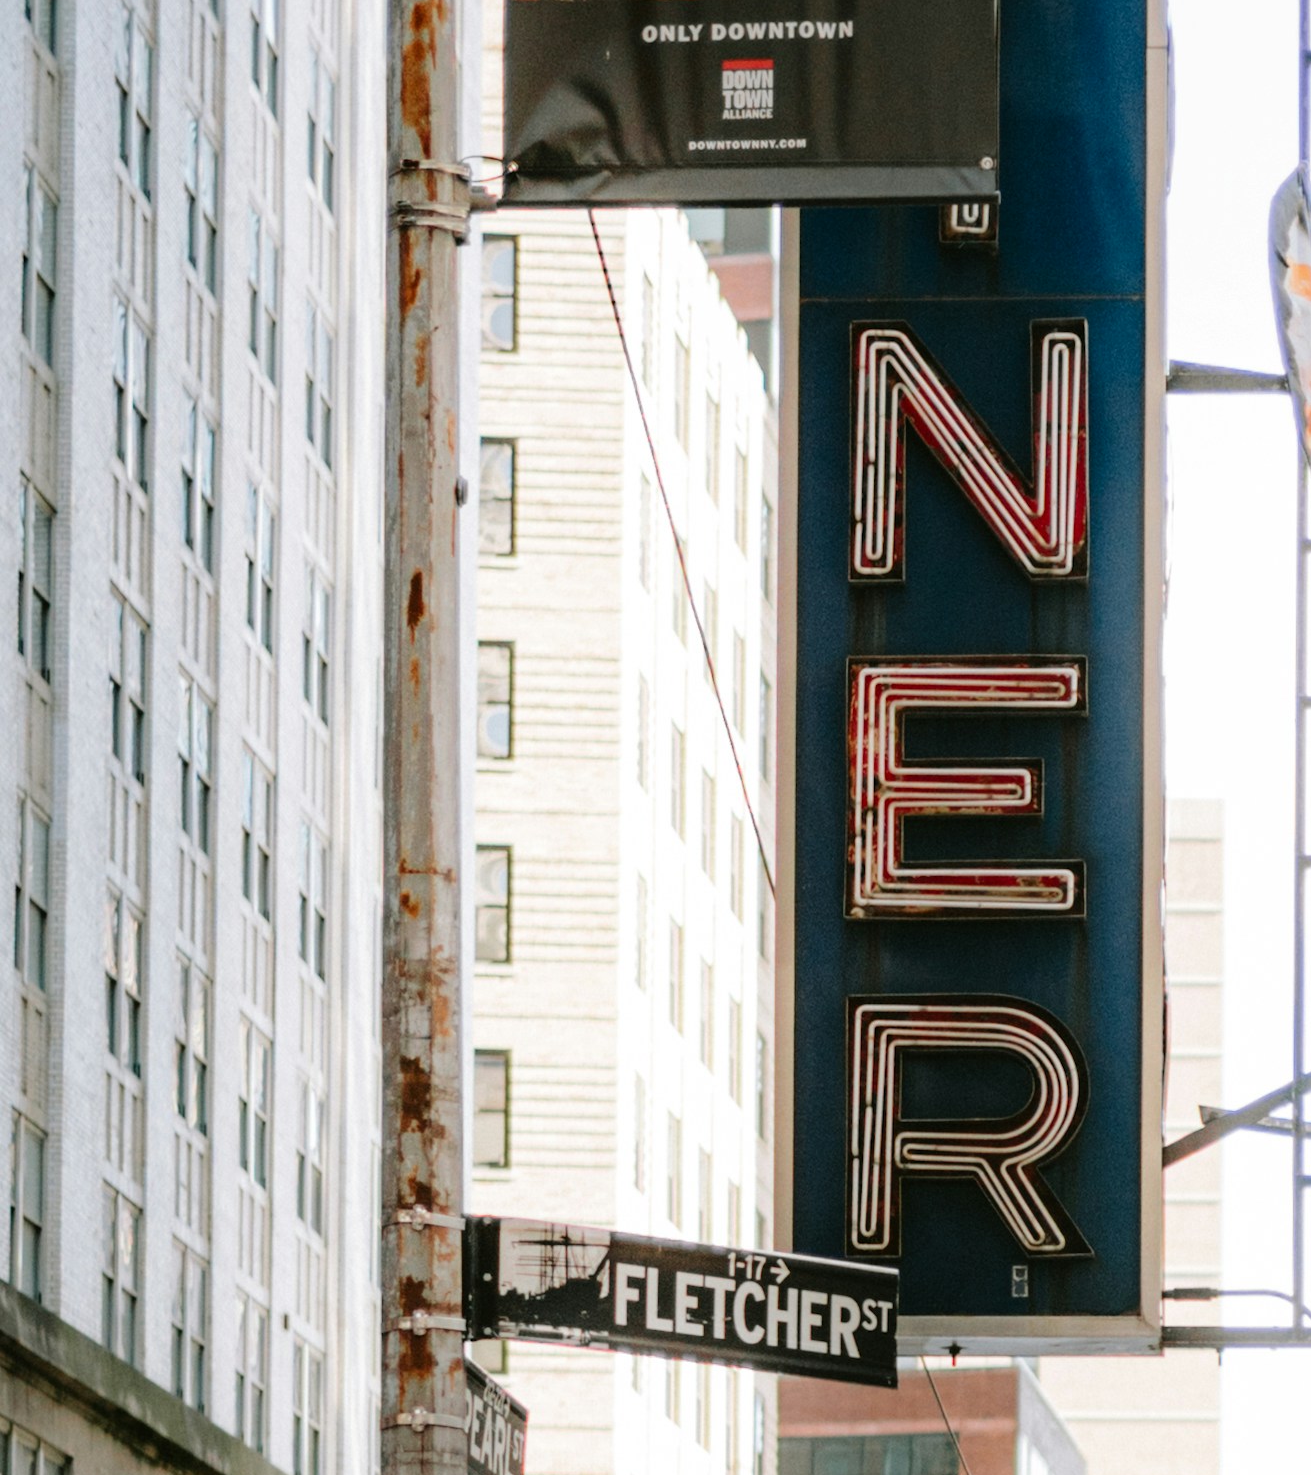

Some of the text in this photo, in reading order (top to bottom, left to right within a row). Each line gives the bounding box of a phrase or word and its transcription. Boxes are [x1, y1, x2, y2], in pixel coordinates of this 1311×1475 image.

[641, 20, 855, 43] ONLY DOWNTOWN
[722, 69, 774, 90] DOWN
[722, 89, 774, 109] TOWN
[722, 108, 774, 120] ALLIANCE
[688, 138, 807, 151] DOWNTOWNNY.COM
[728, 1252, 766, 1281] 1-17
[614, 1262, 893, 1359] FLETCHER ST
